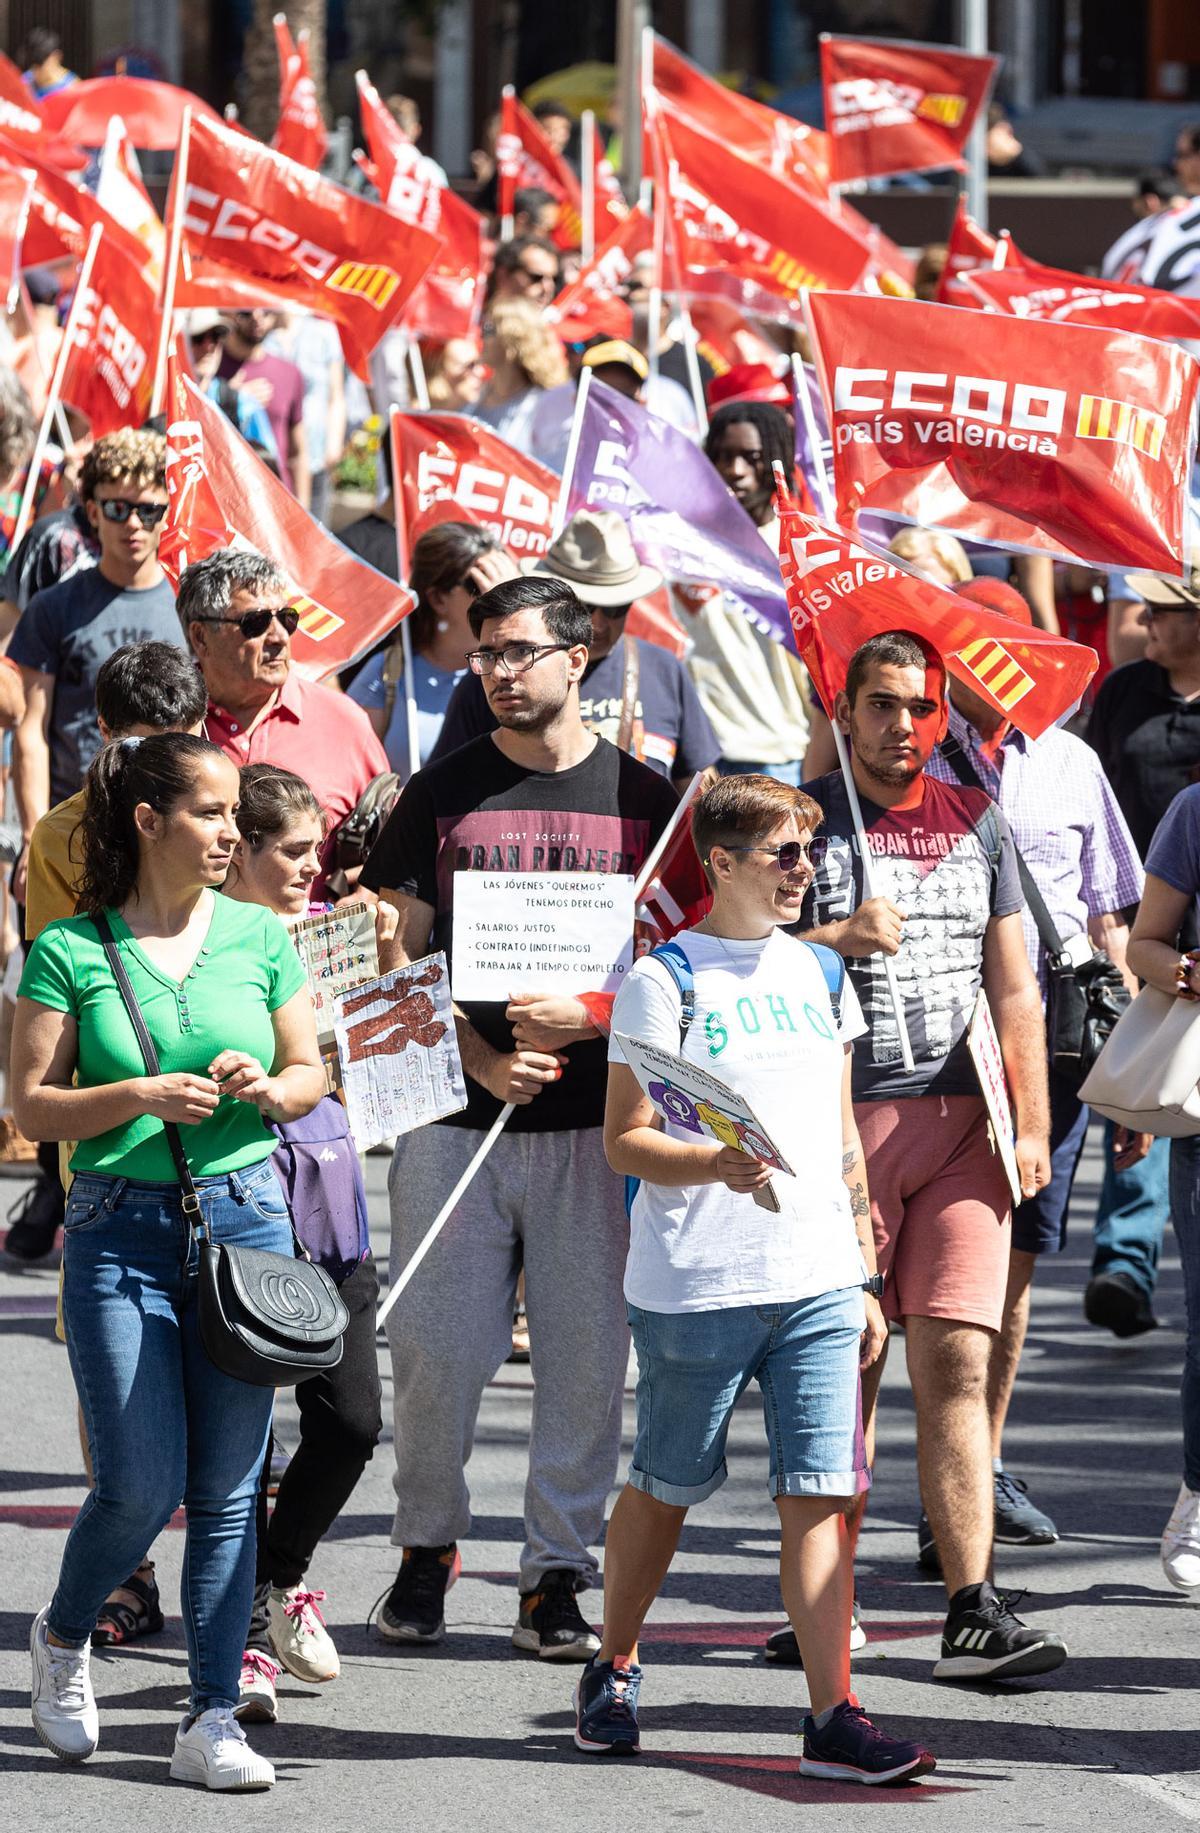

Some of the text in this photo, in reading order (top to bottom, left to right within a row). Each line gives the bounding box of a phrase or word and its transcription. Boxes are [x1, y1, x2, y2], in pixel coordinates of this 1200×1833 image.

[183, 182, 338, 280] CCOO
[834, 366, 1067, 434] CCOO
[836, 414, 1058, 457] país valencià
[418, 441, 559, 528] CCO
[790, 589, 832, 630] aís
[501, 832, 527, 840] LOST
[483, 881, 500, 889] LAS
[504, 878, 544, 890] JÓVENES
[526, 898, 614, 909] TENEMOS DERECHO
[475, 922, 556, 933] SALARIOS JUSTOS
[475, 941, 527, 951] CONTRATO
[476, 960, 625, 973] TRABAJAR A TIEMPO COMPLETO
[705, 994, 834, 1059] SOHO
